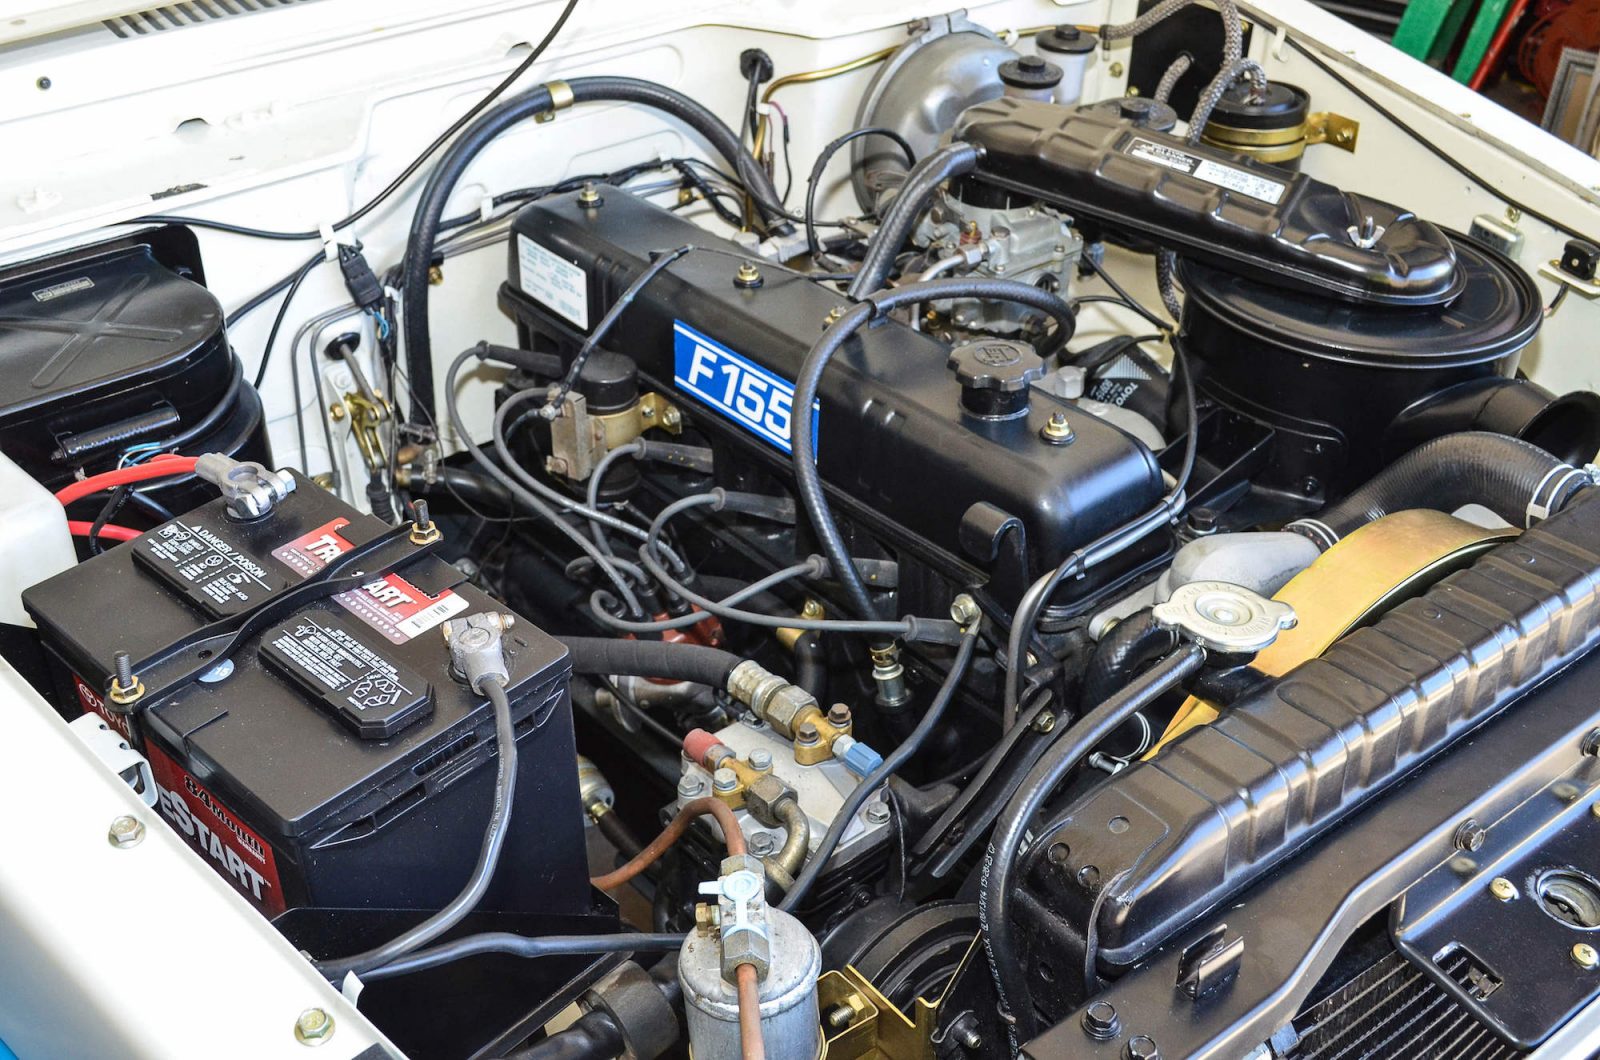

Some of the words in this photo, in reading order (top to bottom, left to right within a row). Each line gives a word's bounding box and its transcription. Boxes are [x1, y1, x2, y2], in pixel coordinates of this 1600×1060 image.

[1116, 382, 1138, 407] TOYO
[200, 529, 233, 556] DANGER
[234, 554, 267, 578] POISON
